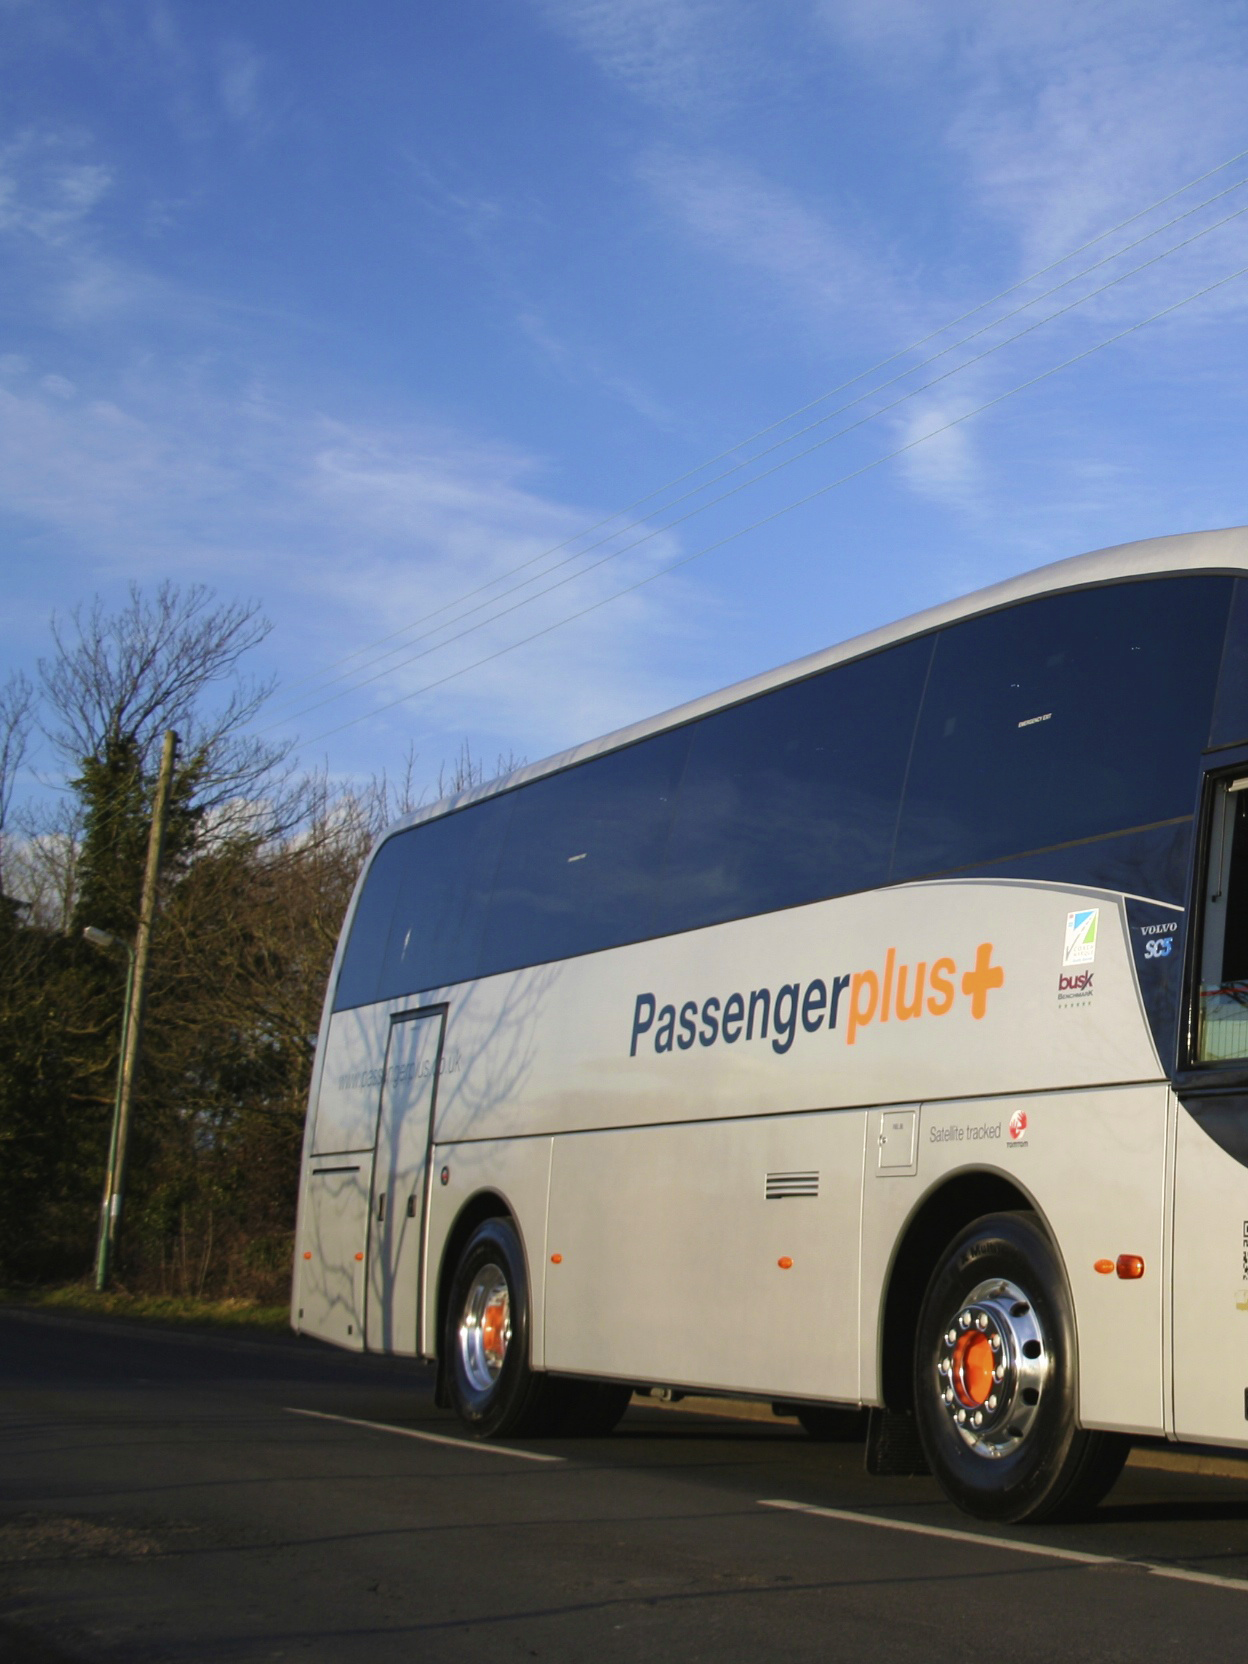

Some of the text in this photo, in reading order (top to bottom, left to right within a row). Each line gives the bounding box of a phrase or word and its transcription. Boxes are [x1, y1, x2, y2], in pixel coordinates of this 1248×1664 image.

[1140, 922, 1178, 936] VOLVO
[1144, 937, 1173, 959] SC5
[1058, 970, 1094, 991] busk
[929, 1121, 1001, 1143] Satellite tracked
